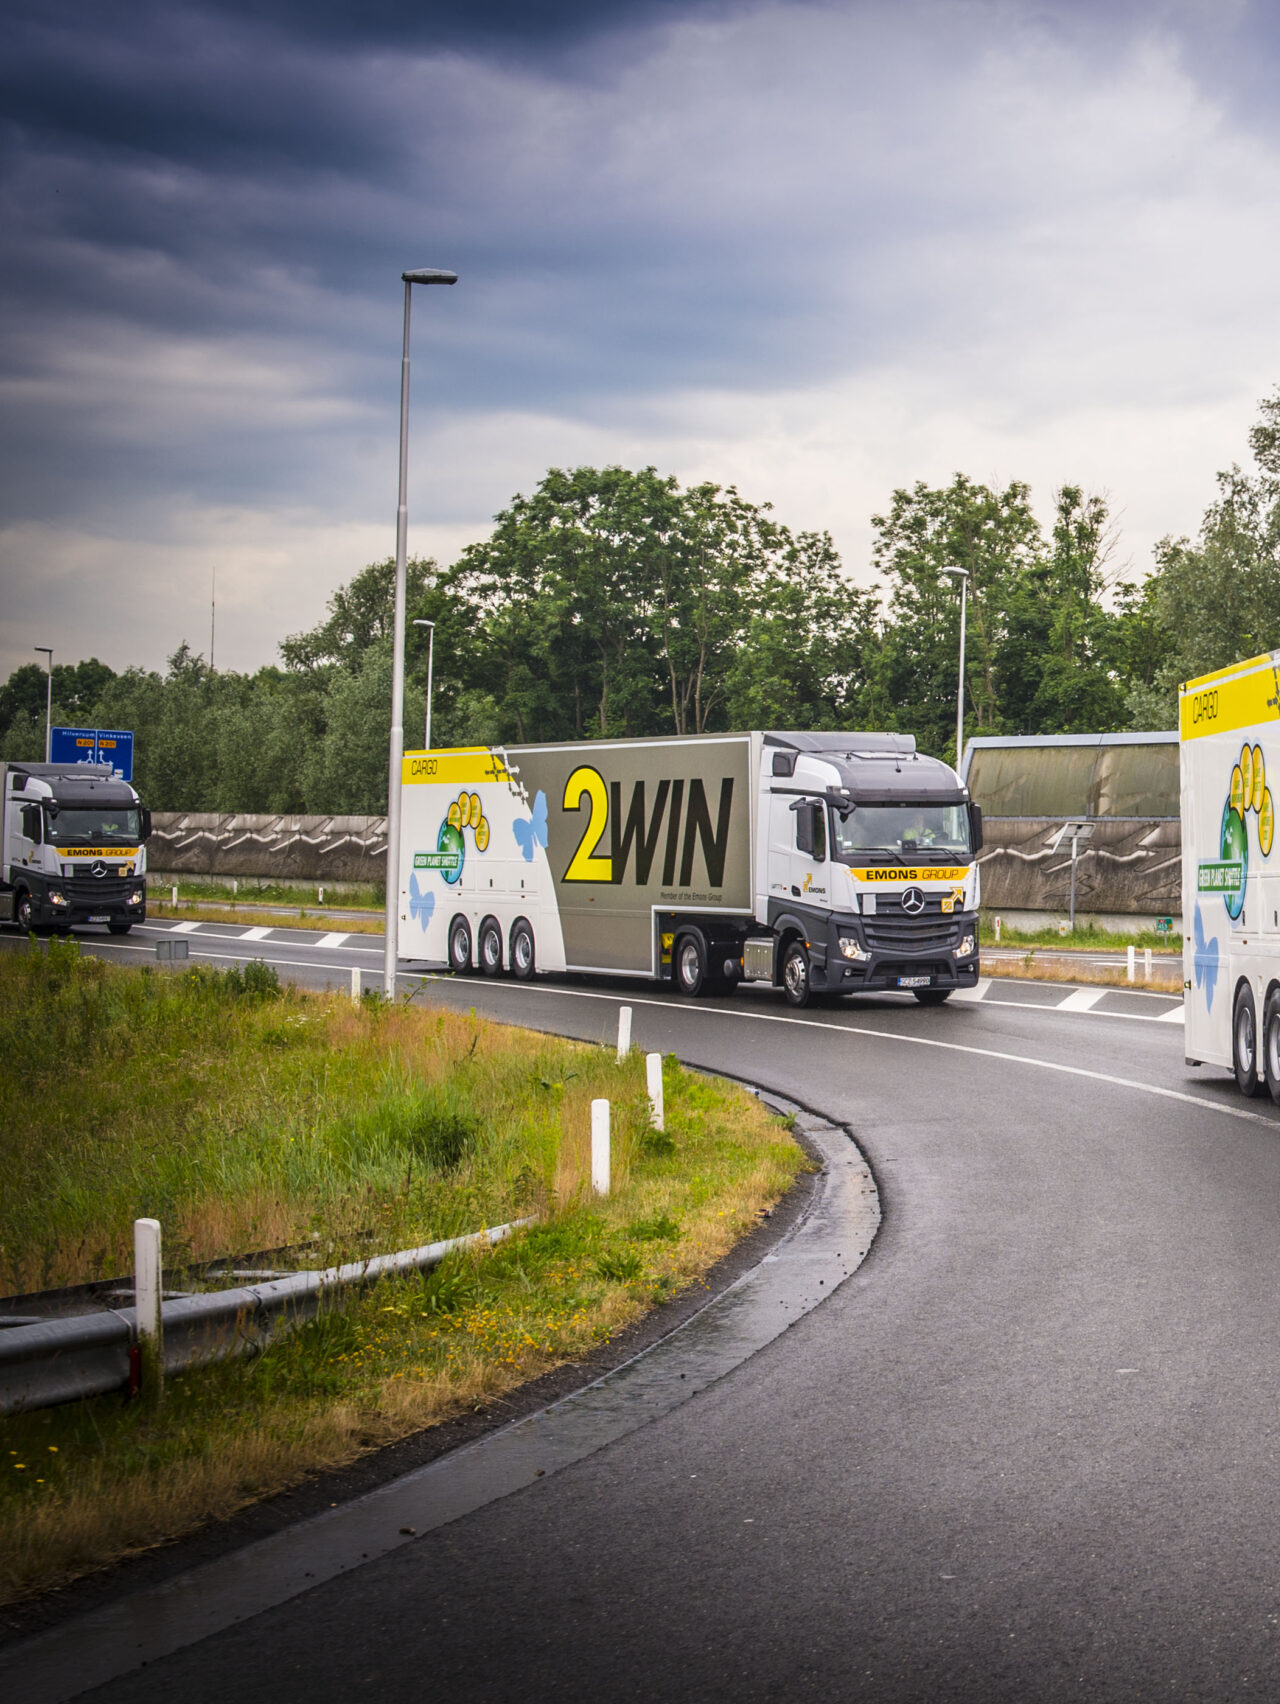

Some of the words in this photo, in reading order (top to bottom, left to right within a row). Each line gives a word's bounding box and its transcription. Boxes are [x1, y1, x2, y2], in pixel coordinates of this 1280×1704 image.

[1193, 690, 1219, 724] CARGO
[99, 732, 132, 740] Vinkeveen
[411, 759, 438, 776] CARGO
[560, 764, 735, 888] 2WIN
[866, 869, 918, 881] EMONS
[922, 868, 960, 880] GROUP
